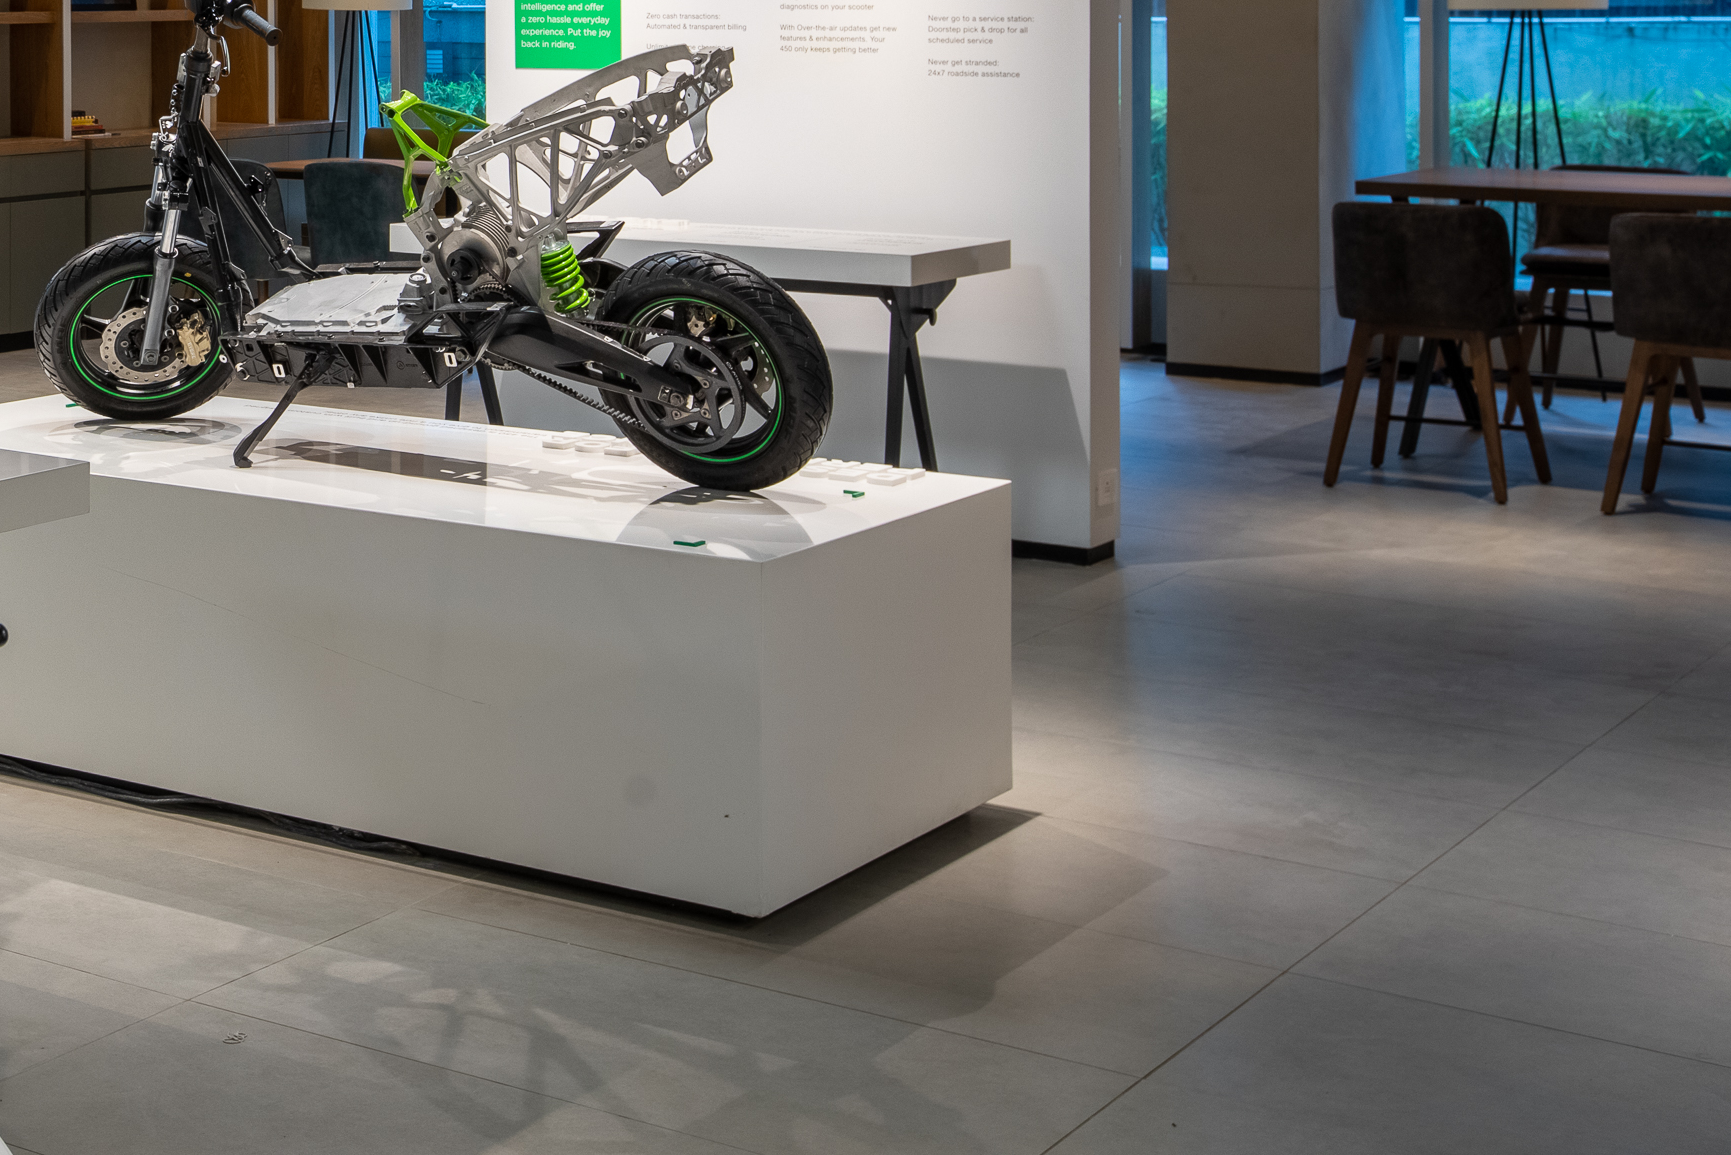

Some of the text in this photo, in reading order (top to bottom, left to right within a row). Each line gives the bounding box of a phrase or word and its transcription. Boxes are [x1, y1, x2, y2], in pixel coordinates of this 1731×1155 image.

[521, 3, 565, 12] intelligence
[567, 3, 582, 11] and
[573, 17, 609, 25] everyday
[521, 28, 565, 36] experience.
[598, 29, 611, 38] joy
[521, 40, 540, 48] back
[551, 41, 576, 50] riding.
